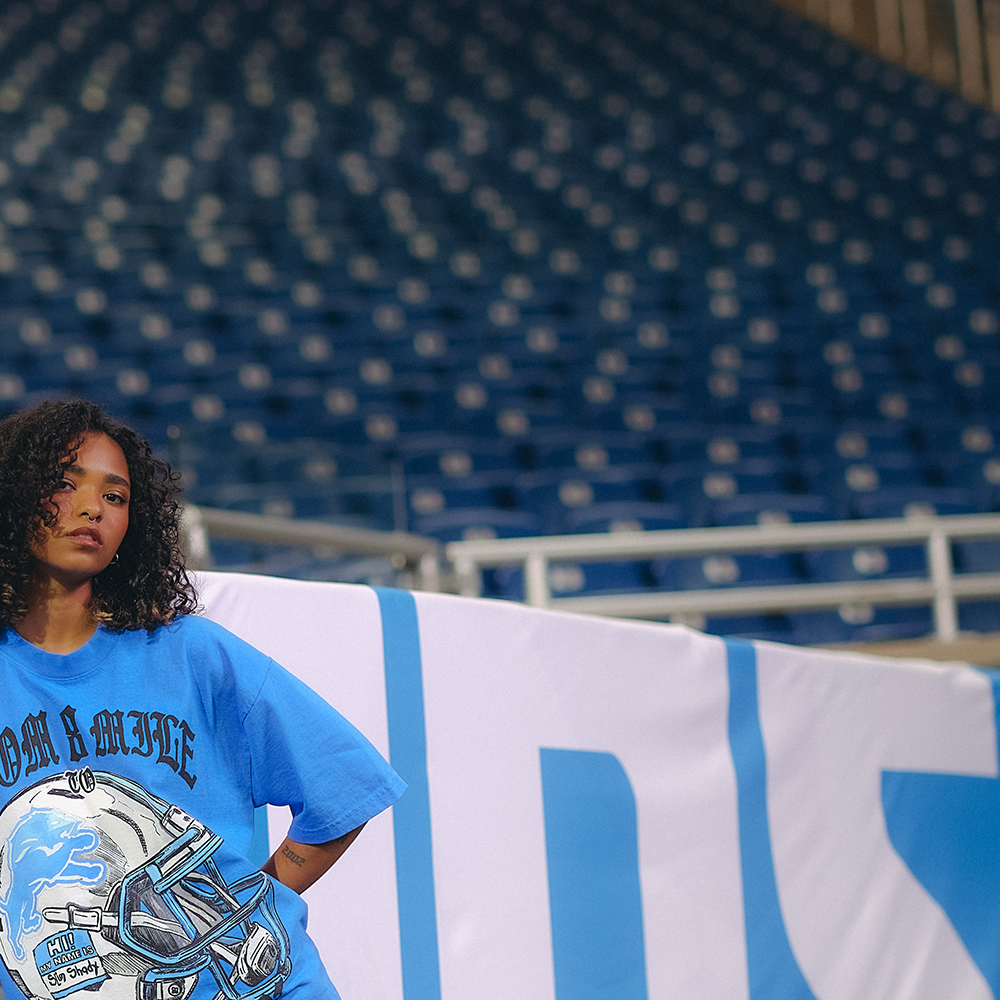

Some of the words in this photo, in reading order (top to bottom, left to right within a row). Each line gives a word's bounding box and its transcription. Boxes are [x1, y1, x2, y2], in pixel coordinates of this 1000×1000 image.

[59, 704, 89, 763] 8
[89, 709, 198, 790] MILE
[65, 767, 97, 794] TO
[47, 932, 75, 957] HI!
[40, 961, 52, 973] MY
[53, 950, 82, 966] NAME
[82, 945, 95, 956] IS
[66, 959, 99, 979] Shady
